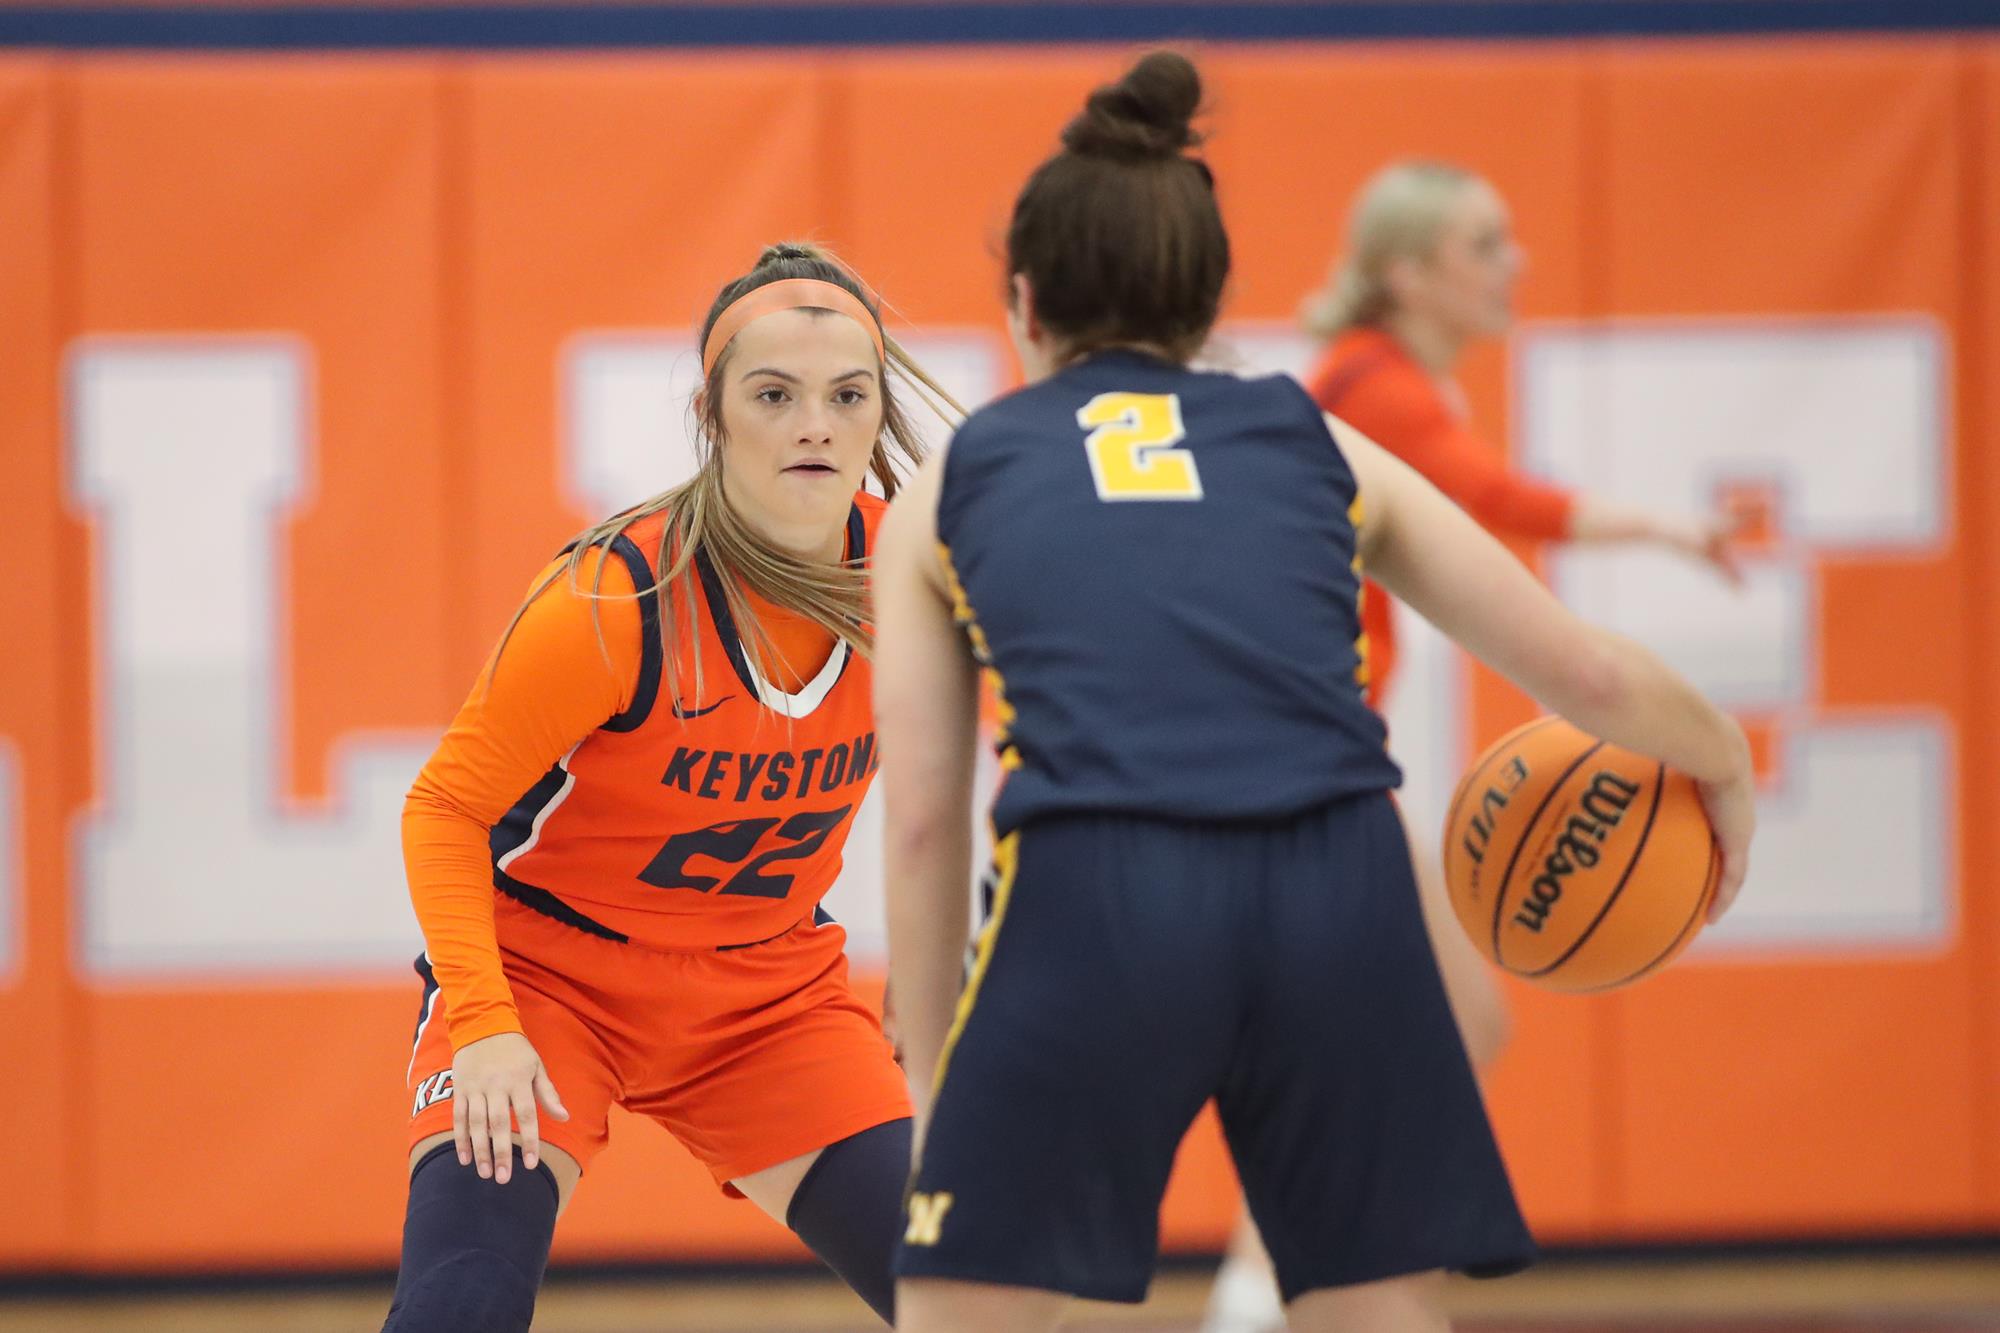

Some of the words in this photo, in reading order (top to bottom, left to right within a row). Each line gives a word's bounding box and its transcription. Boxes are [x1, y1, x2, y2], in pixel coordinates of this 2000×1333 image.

[1076, 391, 1204, 502] 2
[638, 803, 852, 899] 22
[1514, 770, 1640, 933] Wilson
